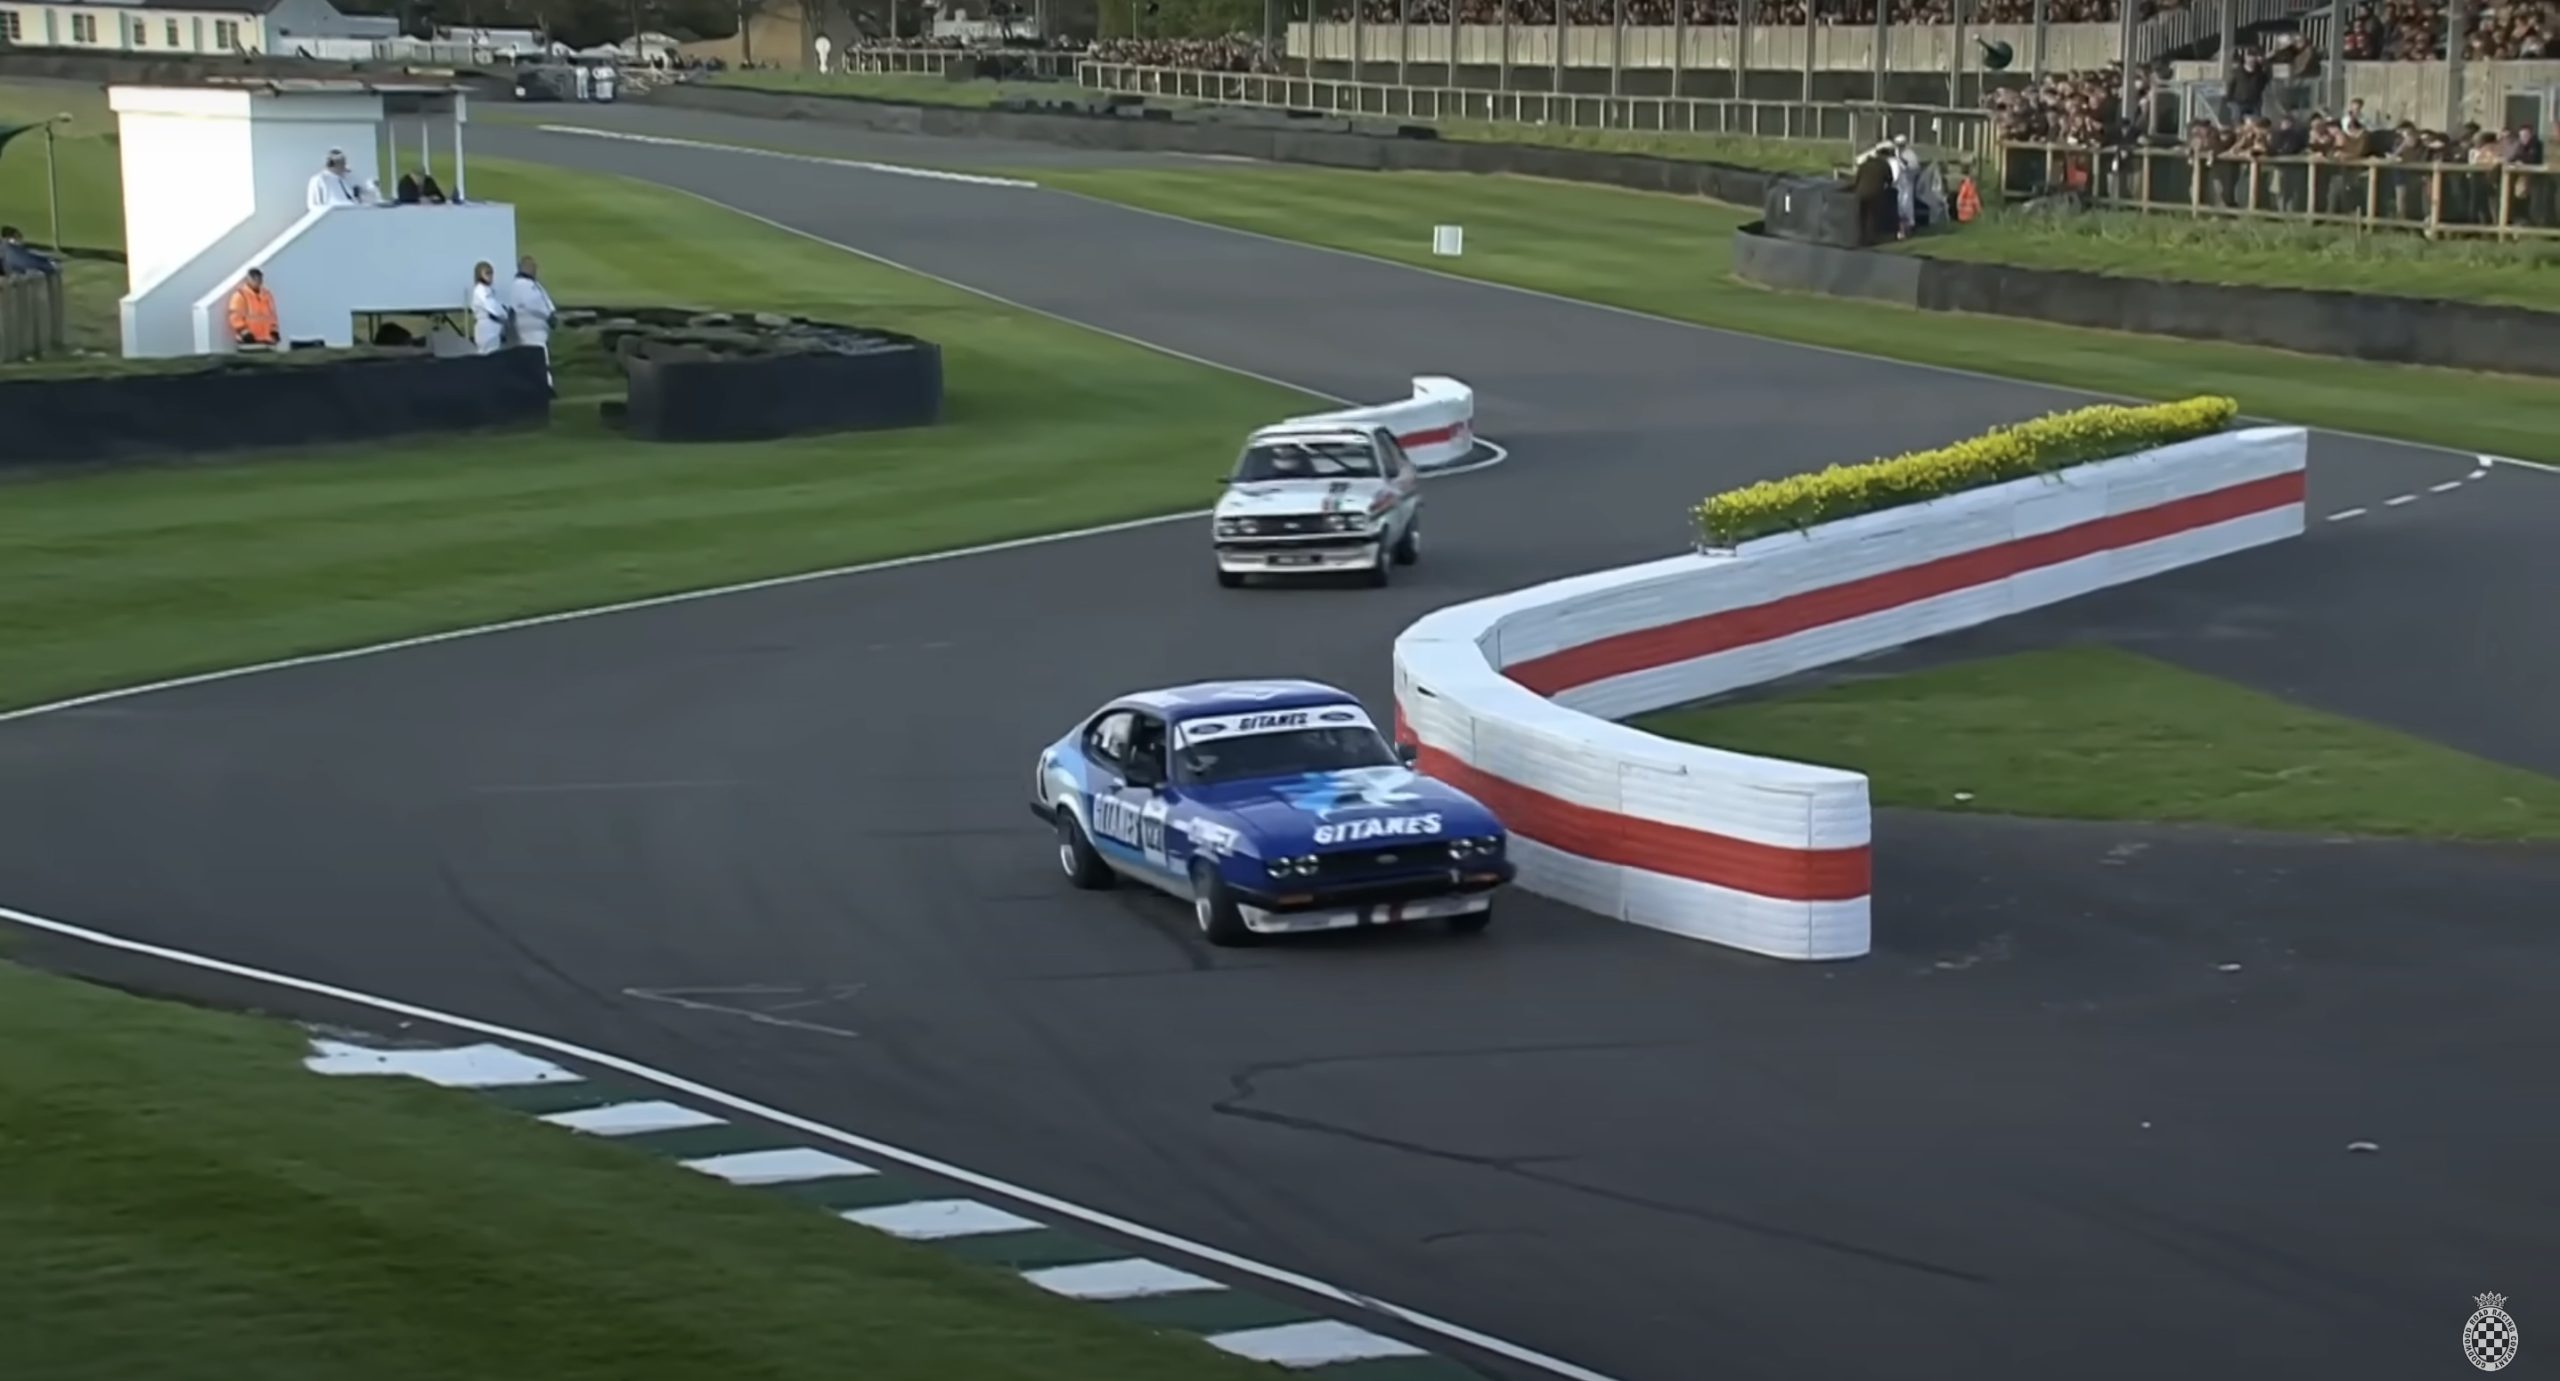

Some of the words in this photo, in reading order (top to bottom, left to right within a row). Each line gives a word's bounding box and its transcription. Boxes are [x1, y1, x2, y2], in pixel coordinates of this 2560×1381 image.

[1238, 712, 1309, 731] GITANES
[1094, 793, 1141, 847] GITANES
[1313, 812, 1443, 845] GITANES
